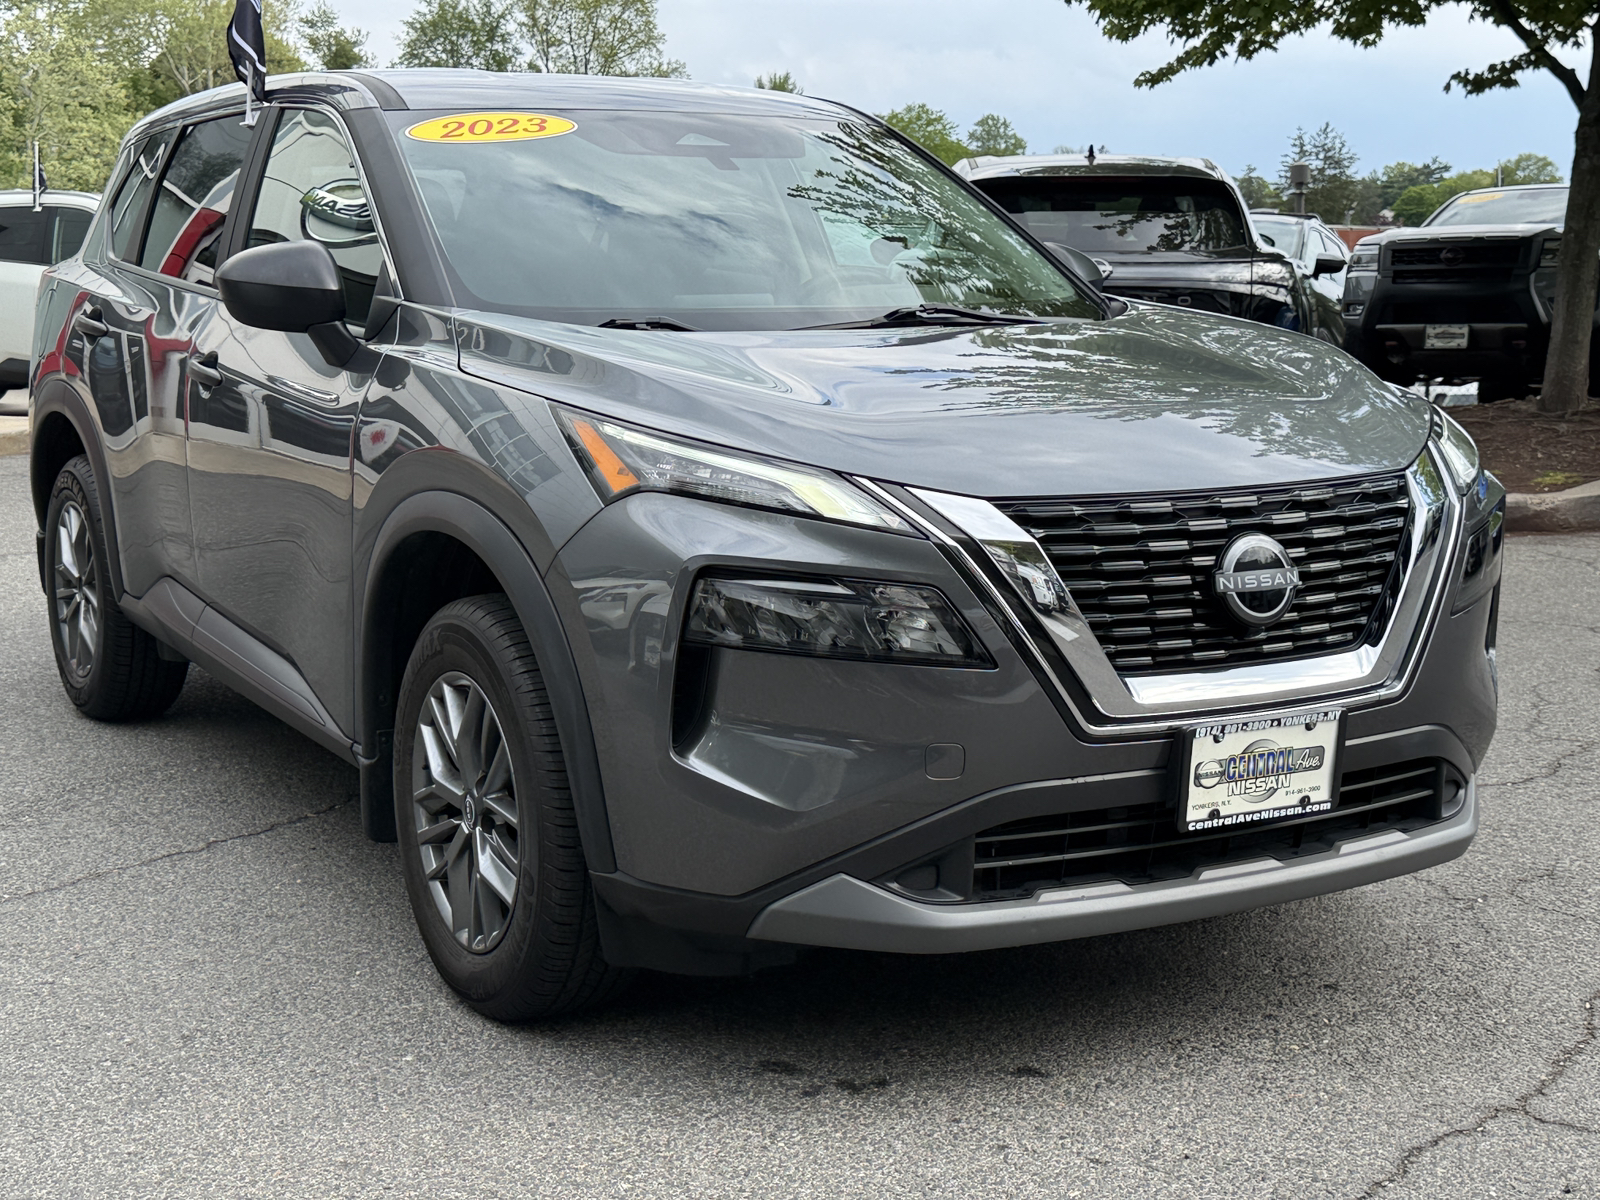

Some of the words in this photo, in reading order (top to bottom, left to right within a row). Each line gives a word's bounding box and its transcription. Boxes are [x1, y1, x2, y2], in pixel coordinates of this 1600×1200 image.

[440, 117, 548, 138] 2023
[1219, 570, 1298, 590] NISSAN
[1226, 747, 1294, 782] CENTRAL
[1227, 774, 1291, 797] NISSAN
